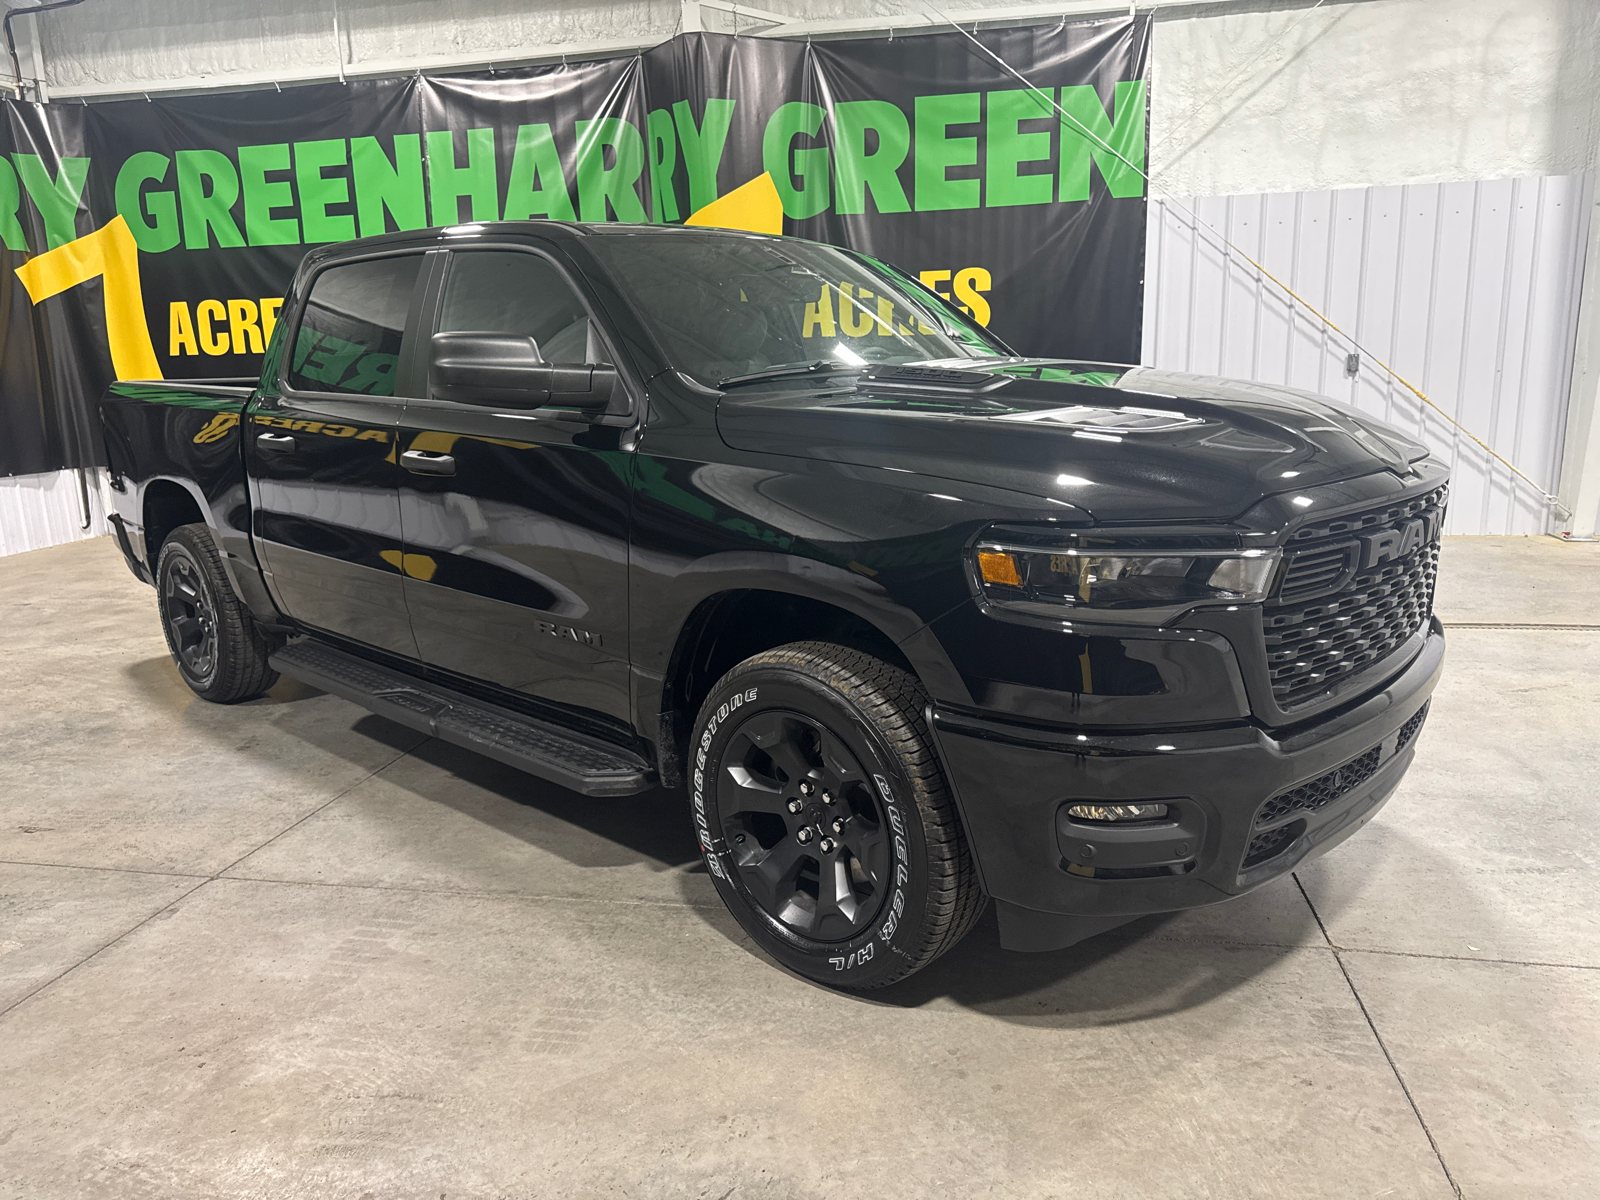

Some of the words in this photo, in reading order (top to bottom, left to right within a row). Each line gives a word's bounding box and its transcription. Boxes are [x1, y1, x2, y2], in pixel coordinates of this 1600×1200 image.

[115, 134, 427, 253] GREEN
[426, 98, 736, 228] HARRY
[762, 80, 1147, 219] GREEN
[1361, 504, 1443, 570] RAM
[533, 619, 604, 647] RAM
[694, 687, 758, 880] BRIDGESTONE
[873, 774, 908, 940] DUELER
[829, 942, 874, 971] H/L
